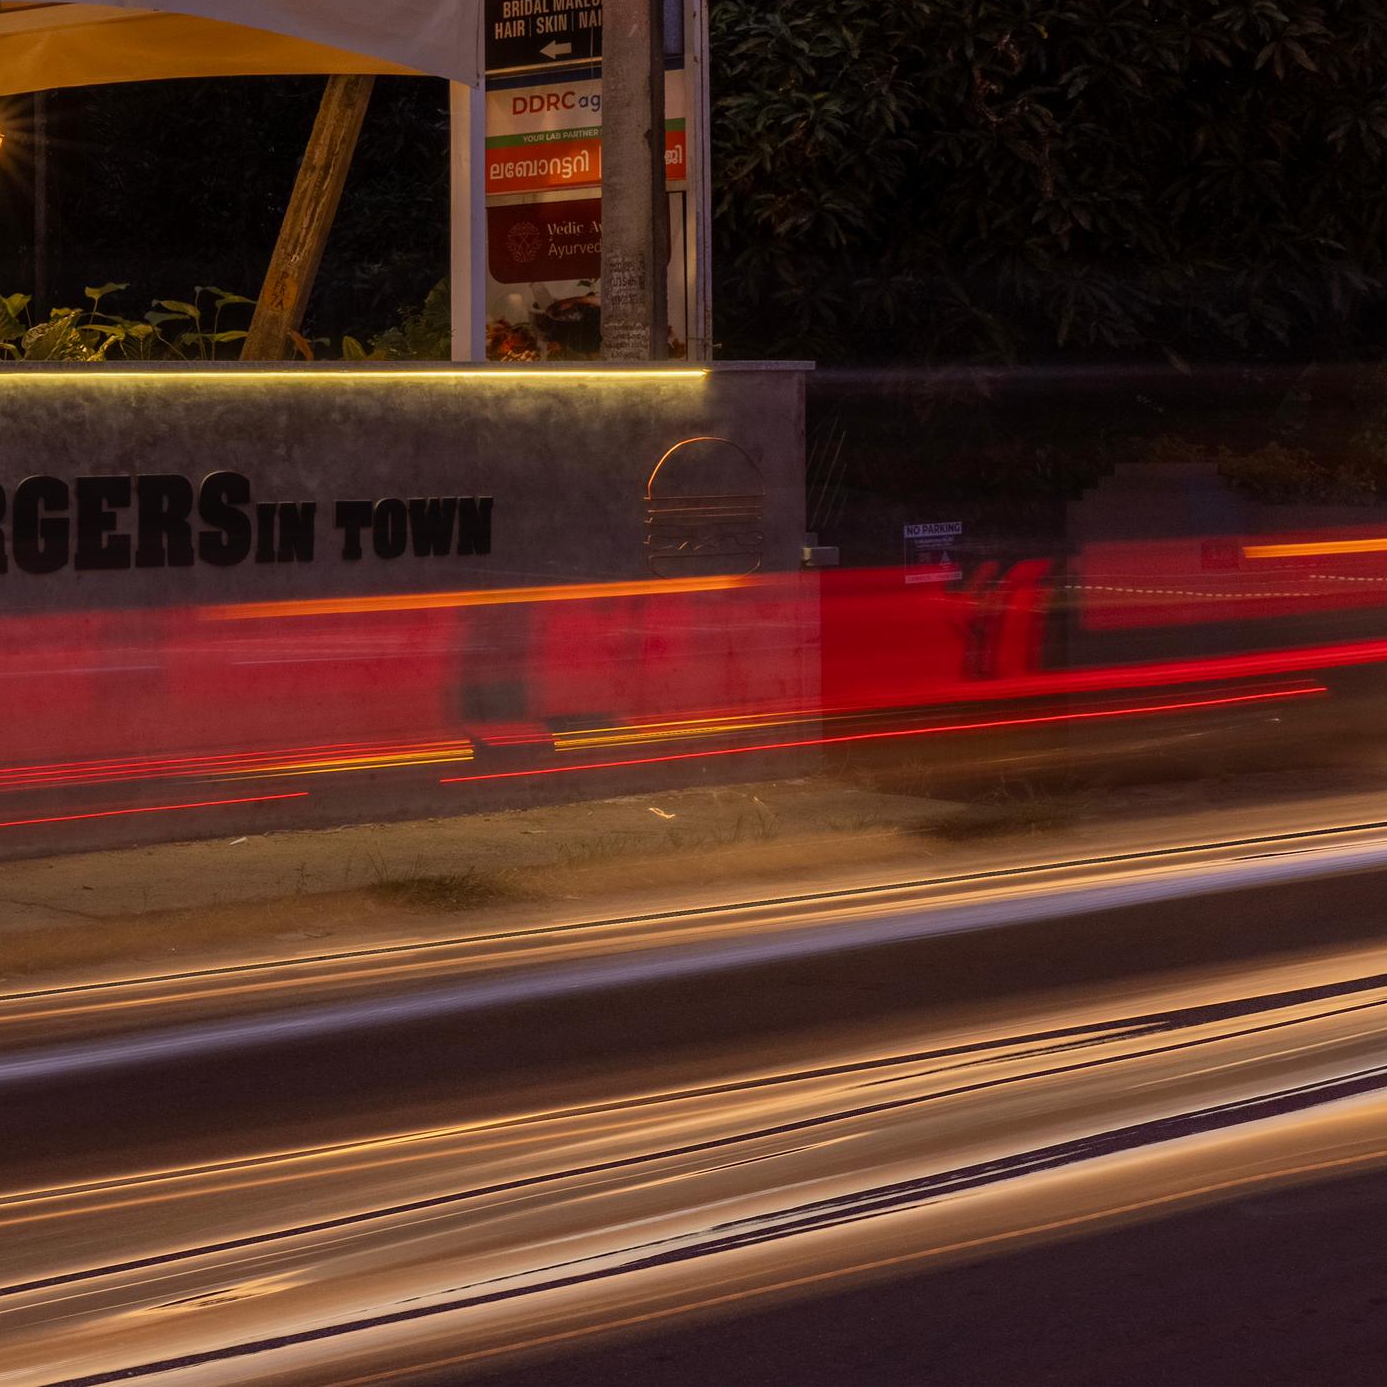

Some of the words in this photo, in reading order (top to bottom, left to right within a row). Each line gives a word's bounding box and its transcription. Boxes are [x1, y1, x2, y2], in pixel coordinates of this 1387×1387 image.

[494, 19, 526, 41] HAIR
[536, 14, 568, 35] SKIN
[578, 8, 604, 30] NAI
[512, 91, 576, 116] DDRC
[523, 134, 545, 146] YOUR
[545, 131, 562, 144] LAB
[563, 129, 599, 142] PARTNER
[489, 149, 590, 181] ലബോറട്ടറി
[547, 220, 586, 237] Vedic
[547, 238, 603, 259] Ayurved
[254, 499, 316, 564] IN
[335, 494, 494, 562] TOWN
[906, 526, 921, 536] NO
[922, 522, 961, 535] PARKING
